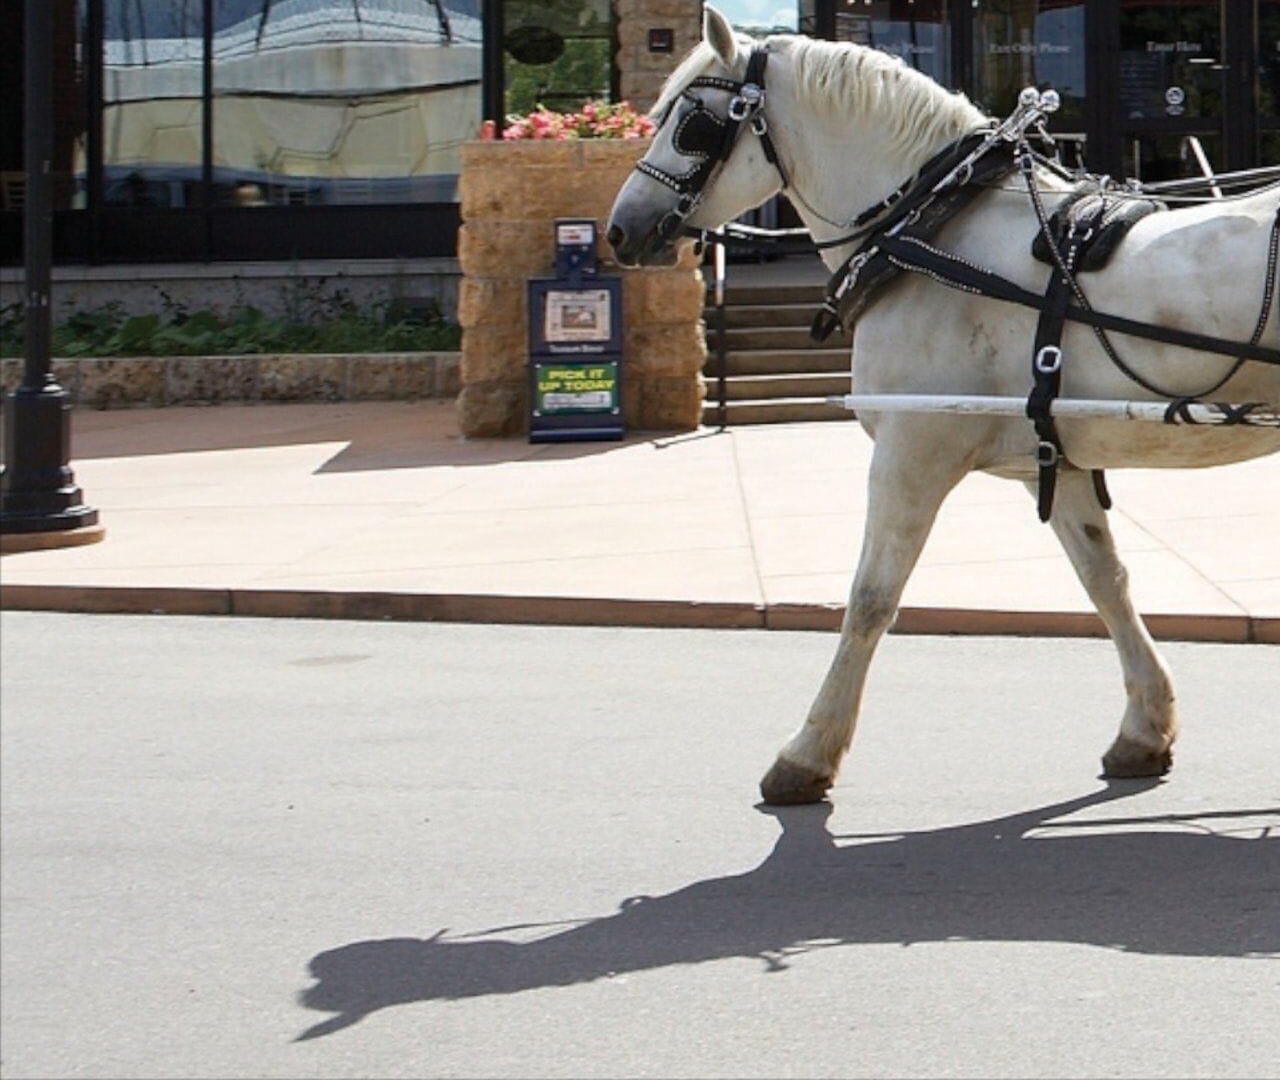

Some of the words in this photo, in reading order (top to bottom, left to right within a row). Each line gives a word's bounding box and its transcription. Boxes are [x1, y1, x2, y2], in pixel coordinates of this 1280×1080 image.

[548, 369, 586, 380] PICK
[589, 368, 605, 379] IT
[537, 381, 561, 392] UP
[563, 380, 615, 391] TODAY
